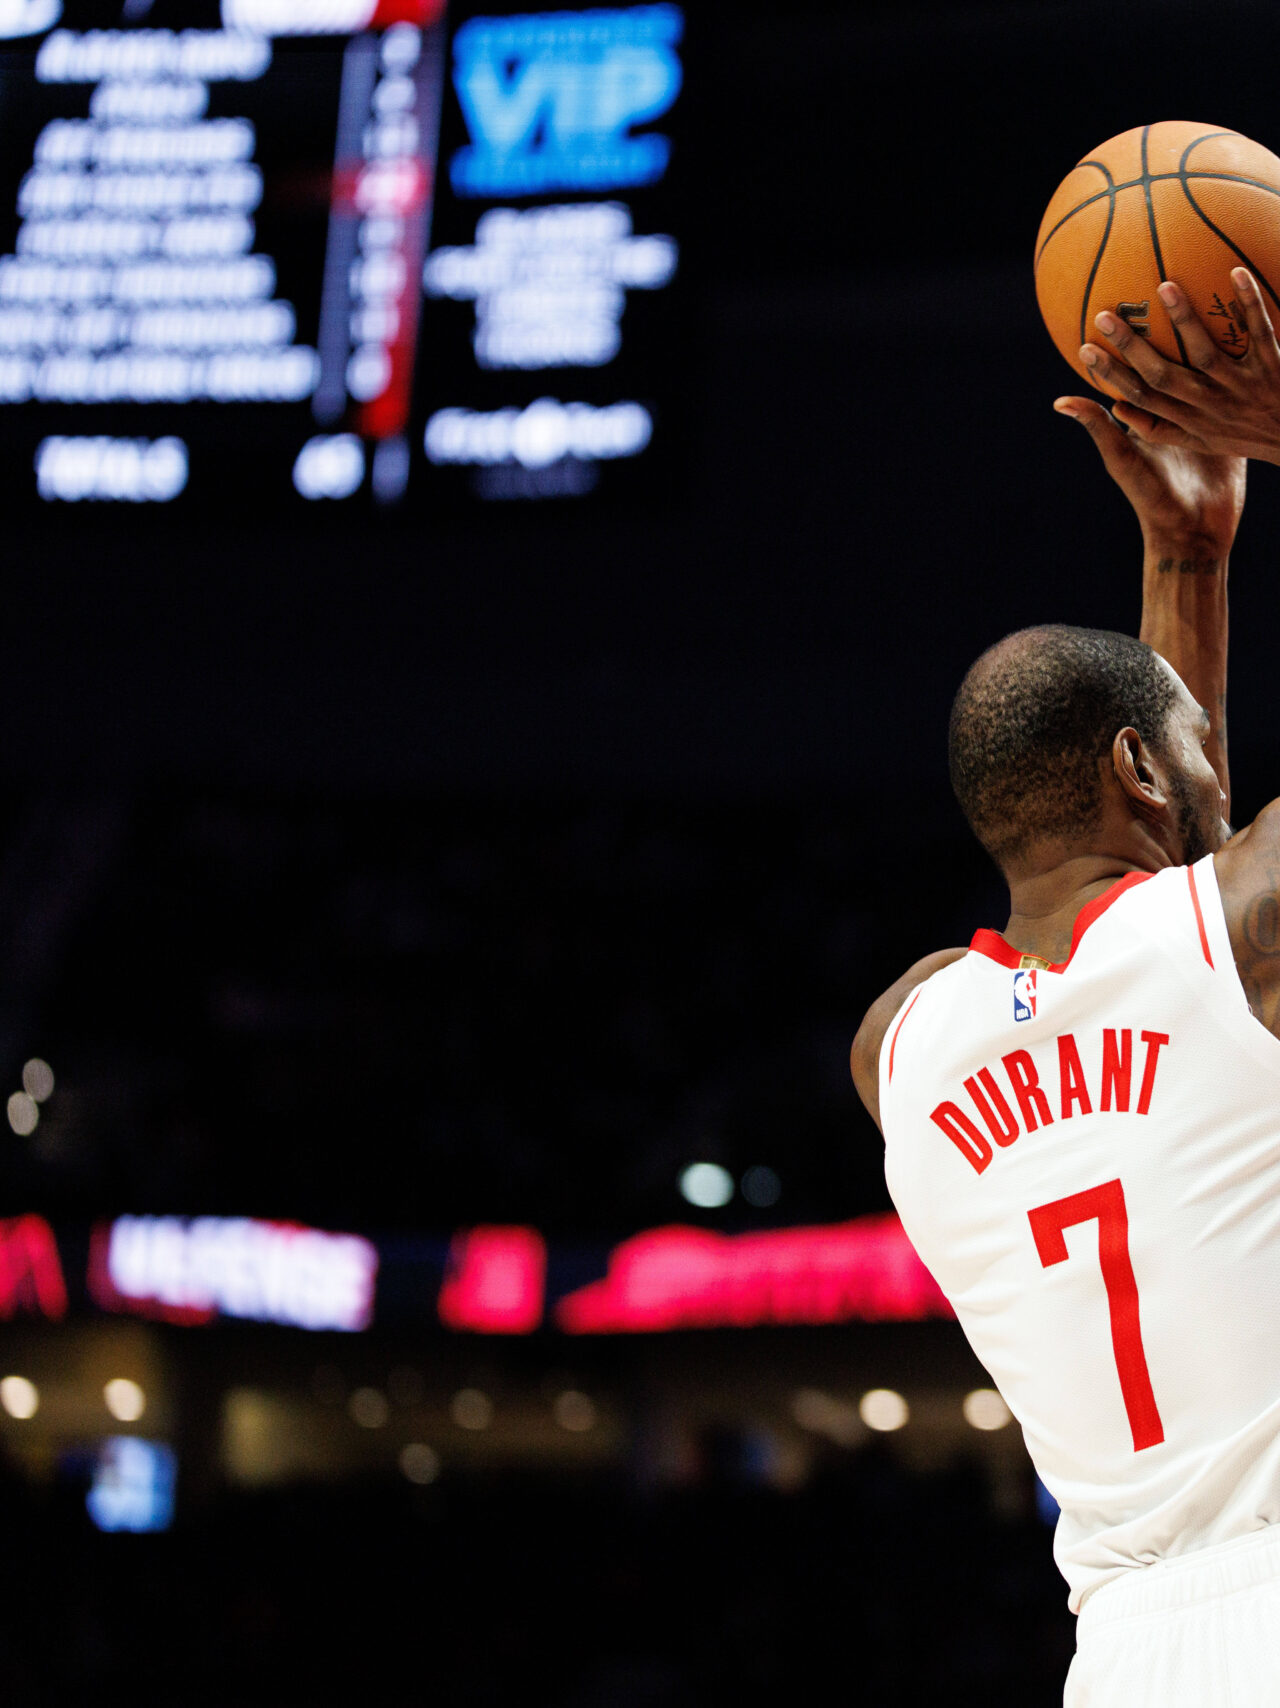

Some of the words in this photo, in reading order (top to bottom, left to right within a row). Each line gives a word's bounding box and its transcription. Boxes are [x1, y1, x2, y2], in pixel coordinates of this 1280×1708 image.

[460, 42, 684, 152] VIP
[930, 1028, 1170, 1175] DURANT
[1027, 1178, 1165, 1453] 7
